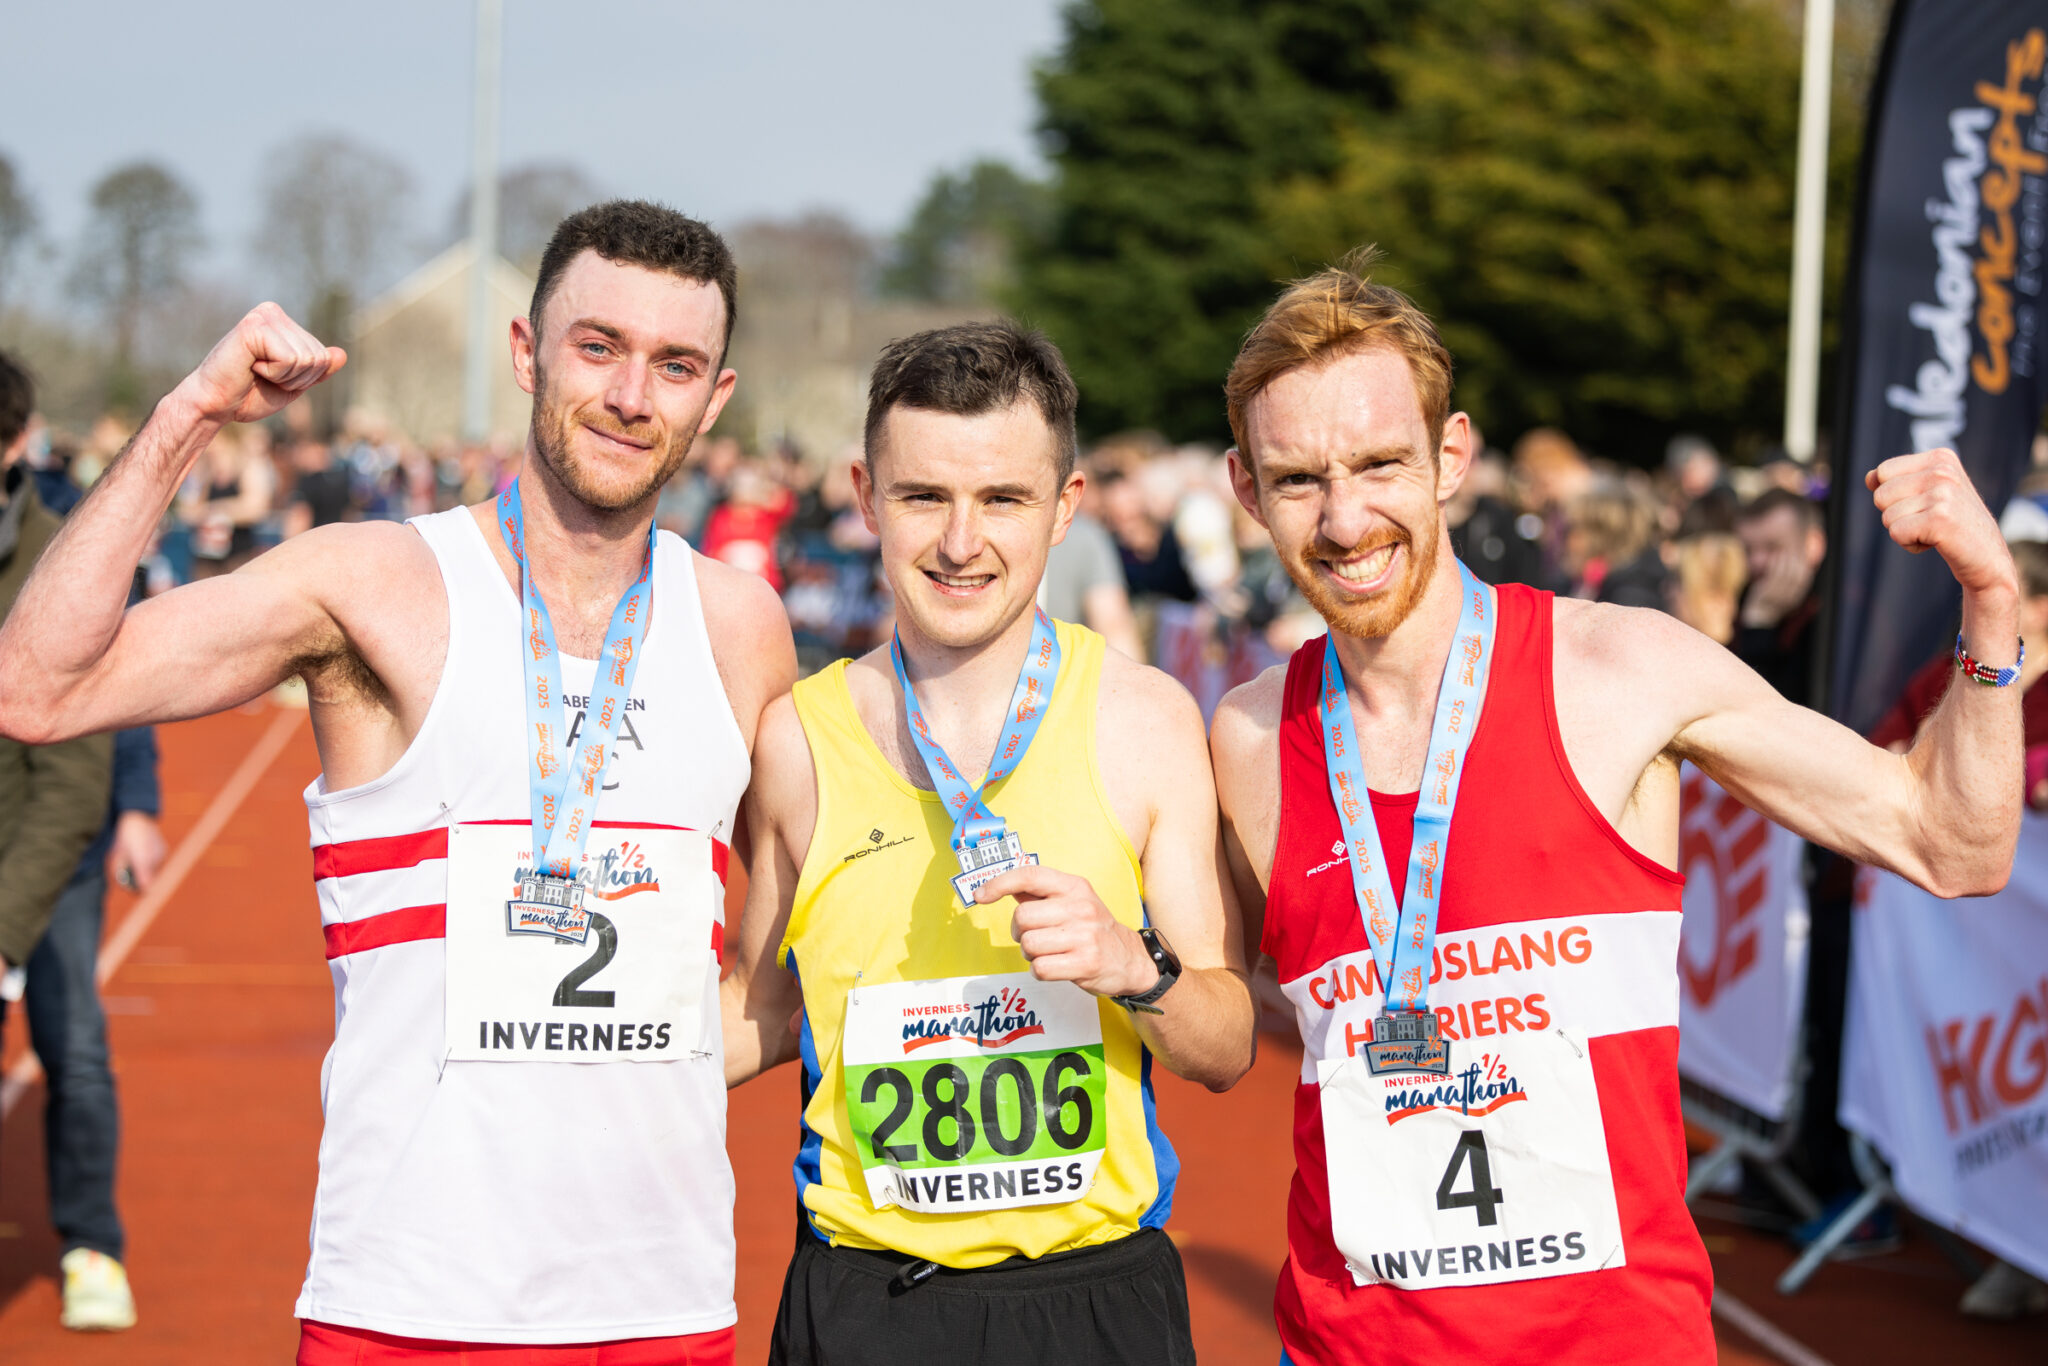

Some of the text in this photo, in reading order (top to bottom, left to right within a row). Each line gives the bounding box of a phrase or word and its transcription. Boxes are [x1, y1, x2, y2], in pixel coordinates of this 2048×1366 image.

[1972, 28, 2047, 394] concepts
[1887, 107, 1994, 455] aledonian
[624, 594, 640, 624] 2025
[1473, 589, 1484, 621] 2025
[1038, 636, 1053, 669] 2025
[536, 674, 550, 709] 2025
[598, 696, 616, 730] 2025
[1448, 698, 1465, 734] 2025
[1003, 733, 1022, 760] 2025
[1331, 723, 1345, 757] 2025
[935, 755, 957, 781] 2025
[543, 794, 556, 830] 2025
[565, 807, 585, 842] 2025
[843, 836, 915, 863] RONHILL
[1355, 837, 1372, 874] 2025
[958, 867, 1001, 884] INVERNESS
[513, 904, 555, 916] INVERNESS
[520, 909, 585, 932] marathon
[1412, 913, 1427, 950] 2025
[551, 911, 618, 1008] 2
[902, 1003, 971, 1017] INVERNESS
[902, 995, 1042, 1047] marathon
[1345, 993, 1551, 1057] HRIERS
[479, 1021, 672, 1051] INVERNESS
[1370, 1045, 1412, 1053] INVERNESS
[1379, 1044, 1444, 1066] marathon
[1384, 1072, 1454, 1088] INVERNESS
[1384, 1062, 1524, 1116] marathon
[860, 1051, 1093, 1162] 2806
[895, 1162, 1083, 1204] INVERNESS
[1435, 1129, 1504, 1227] 4
[1371, 1231, 1586, 1280] INVERNESS
